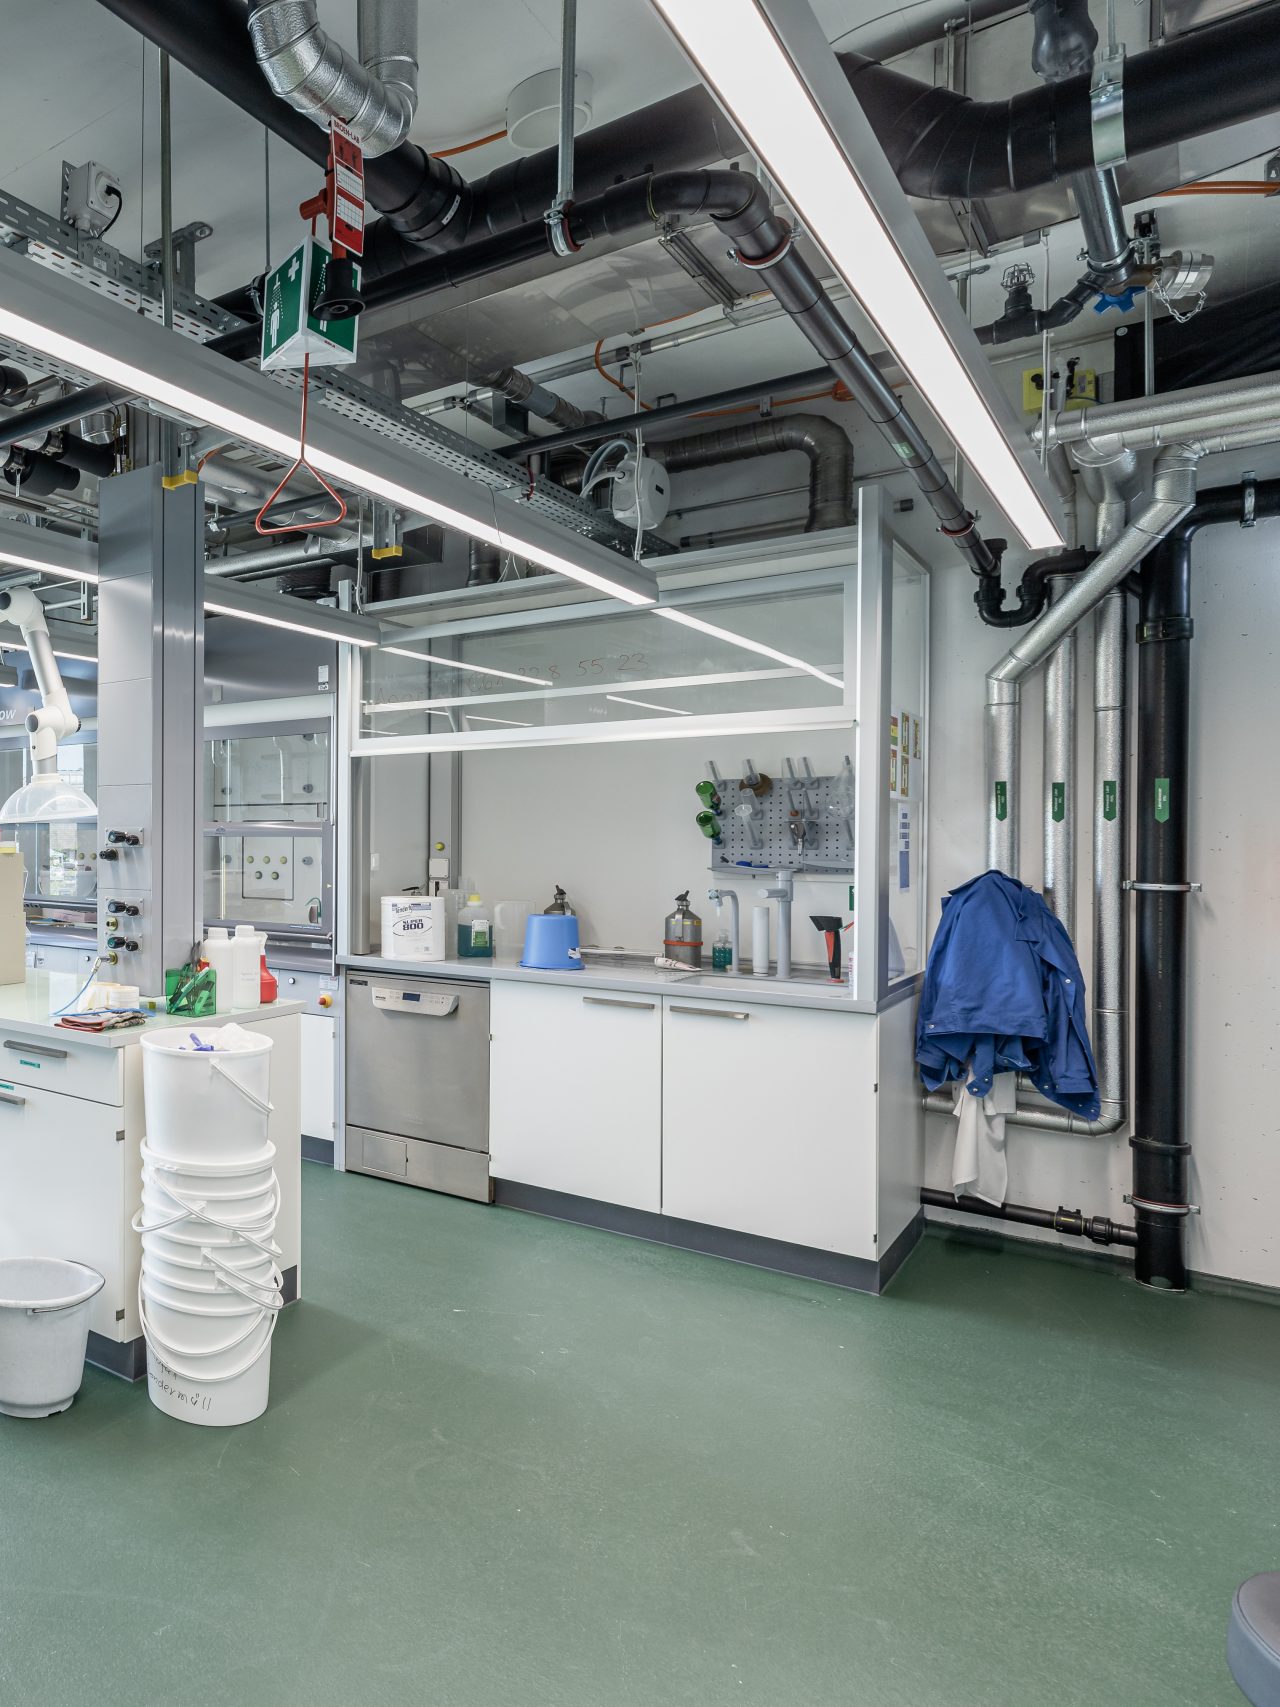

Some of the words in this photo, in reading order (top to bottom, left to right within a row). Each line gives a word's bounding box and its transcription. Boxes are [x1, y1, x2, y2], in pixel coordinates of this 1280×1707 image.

[575, 658, 606, 677] 55
[616, 652, 649, 671] 23
[402, 923, 424, 931] 800
